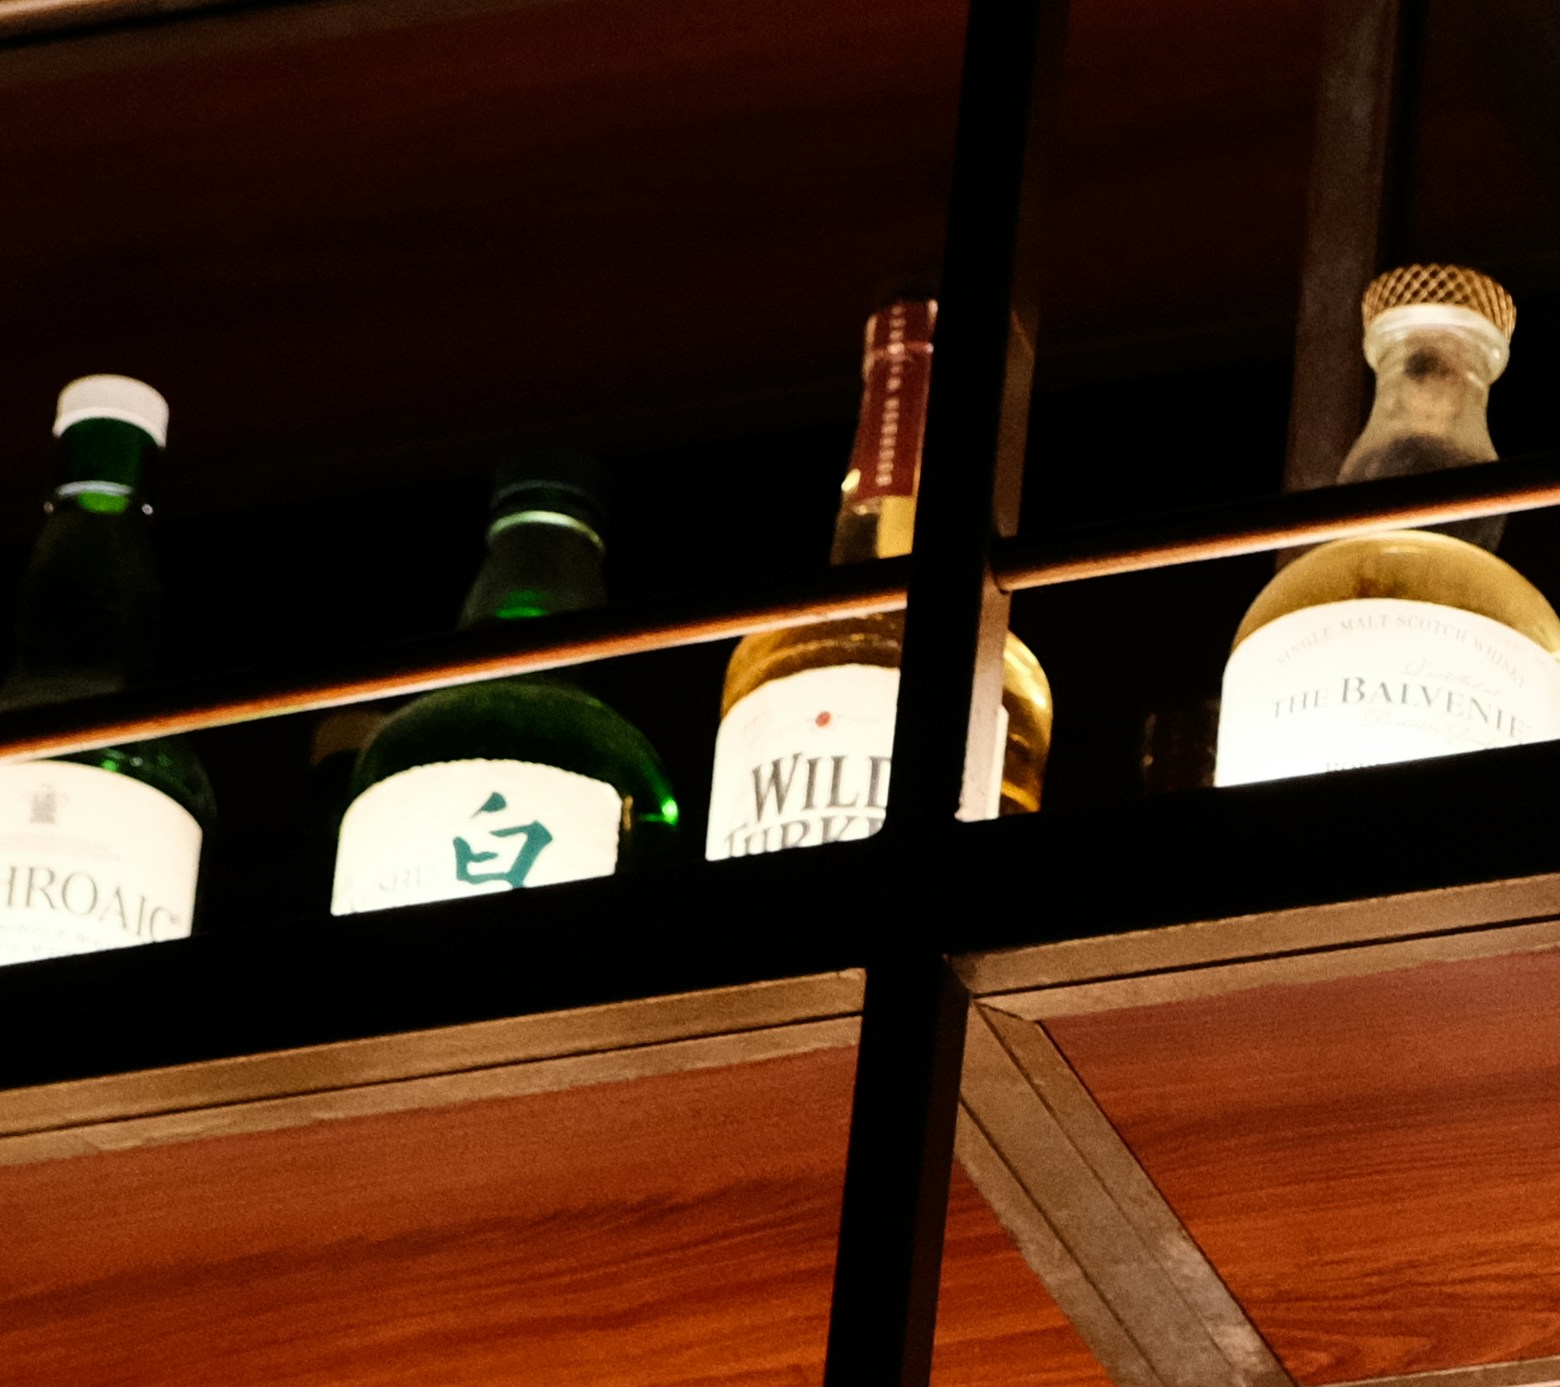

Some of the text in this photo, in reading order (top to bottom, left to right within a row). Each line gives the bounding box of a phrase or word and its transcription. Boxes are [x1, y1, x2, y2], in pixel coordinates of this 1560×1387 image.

[1340, 614, 1389, 632] MALT
[1396, 614, 1467, 643] SCOTCH
[1273, 686, 1330, 719] THE
[1340, 676, 1532, 739] BALVENIE
